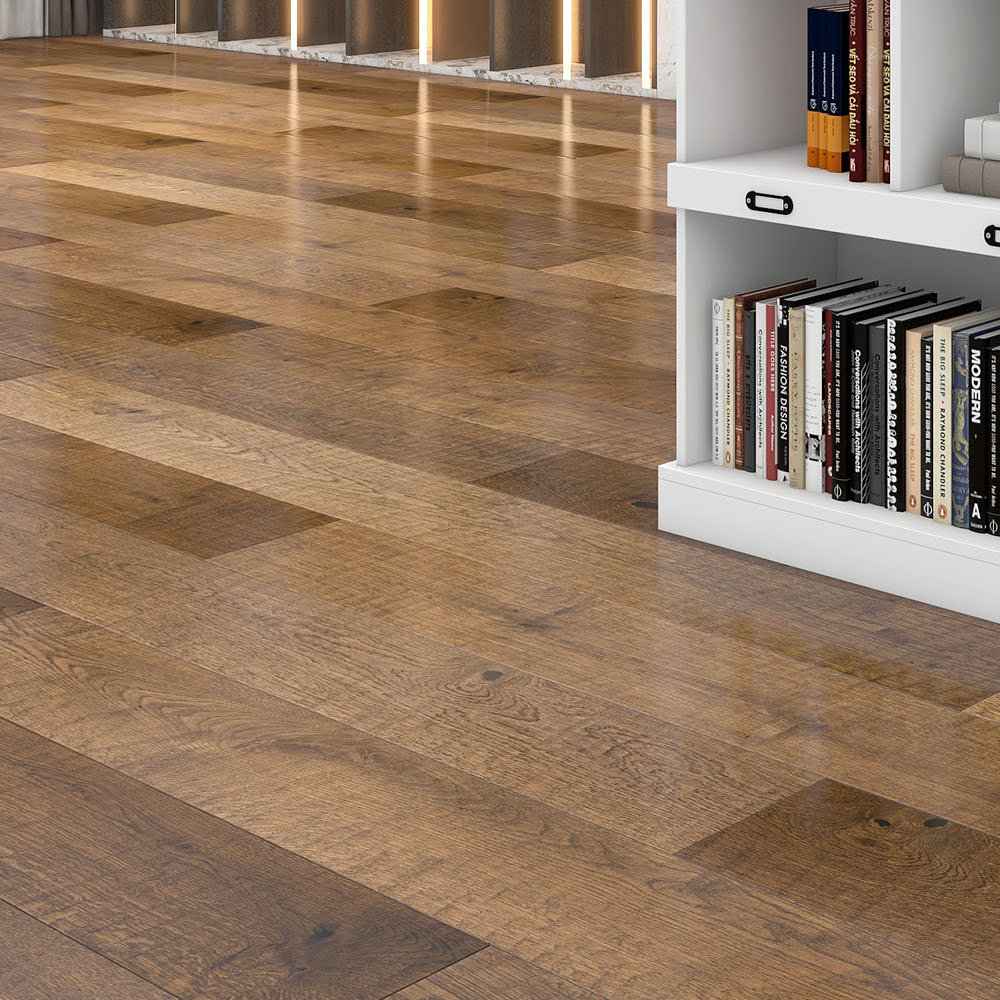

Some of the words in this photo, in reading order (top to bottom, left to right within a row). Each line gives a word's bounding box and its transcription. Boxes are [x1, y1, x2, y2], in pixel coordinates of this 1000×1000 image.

[780, 344, 788, 395] FASHION
[971, 348, 981, 423] MODERN
[780, 397, 788, 440] DESIGN
[971, 502, 981, 519] A
